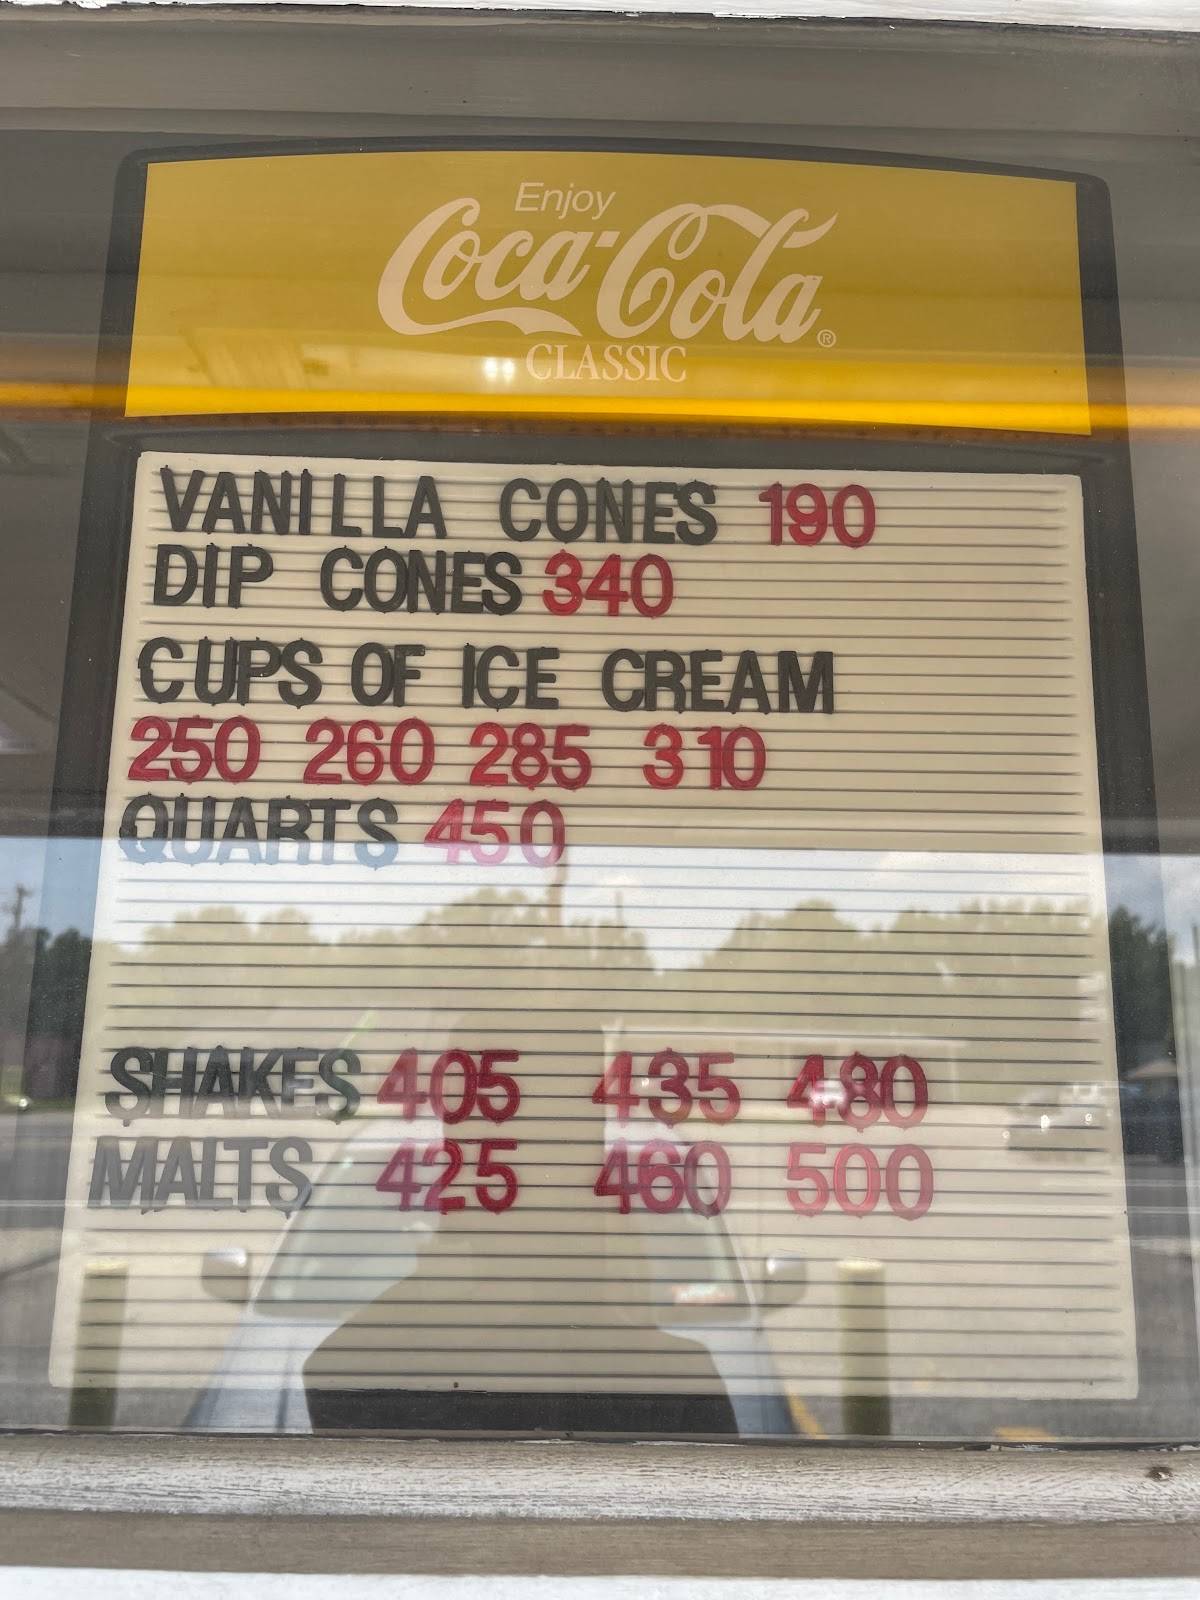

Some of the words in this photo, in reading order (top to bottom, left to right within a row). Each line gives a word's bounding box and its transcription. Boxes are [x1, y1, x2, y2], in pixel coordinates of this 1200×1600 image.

[514, 182, 617, 220] Enjoy
[377, 197, 838, 343] Coca-Cola
[526, 343, 688, 383] CLASSIC
[160, 466, 447, 538] VANILLA
[500, 477, 718, 546] CONES
[759, 481, 876, 548] 190
[153, 543, 274, 608] DIP
[320, 545, 522, 615] CONES
[542, 550, 674, 618] 340
[137, 636, 323, 708] CUPS
[350, 641, 426, 708] OF
[461, 643, 560, 710] ICE
[601, 648, 834, 714] CREAM
[128, 715, 261, 785] 250
[303, 716, 435, 786] 260
[469, 721, 592, 791] 285
[642, 723, 766, 791] 310
[119, 793, 399, 869] QUARTS
[424, 798, 566, 868] 450
[104, 1045, 362, 1126] SHAKES
[376, 1048, 521, 1125] 405
[592, 1048, 741, 1127] 435
[787, 1051, 928, 1131] 480
[87, 1136, 313, 1218] MALTS
[375, 1138, 519, 1214] 425
[594, 1138, 732, 1217] 460
[786, 1141, 934, 1219] 500
